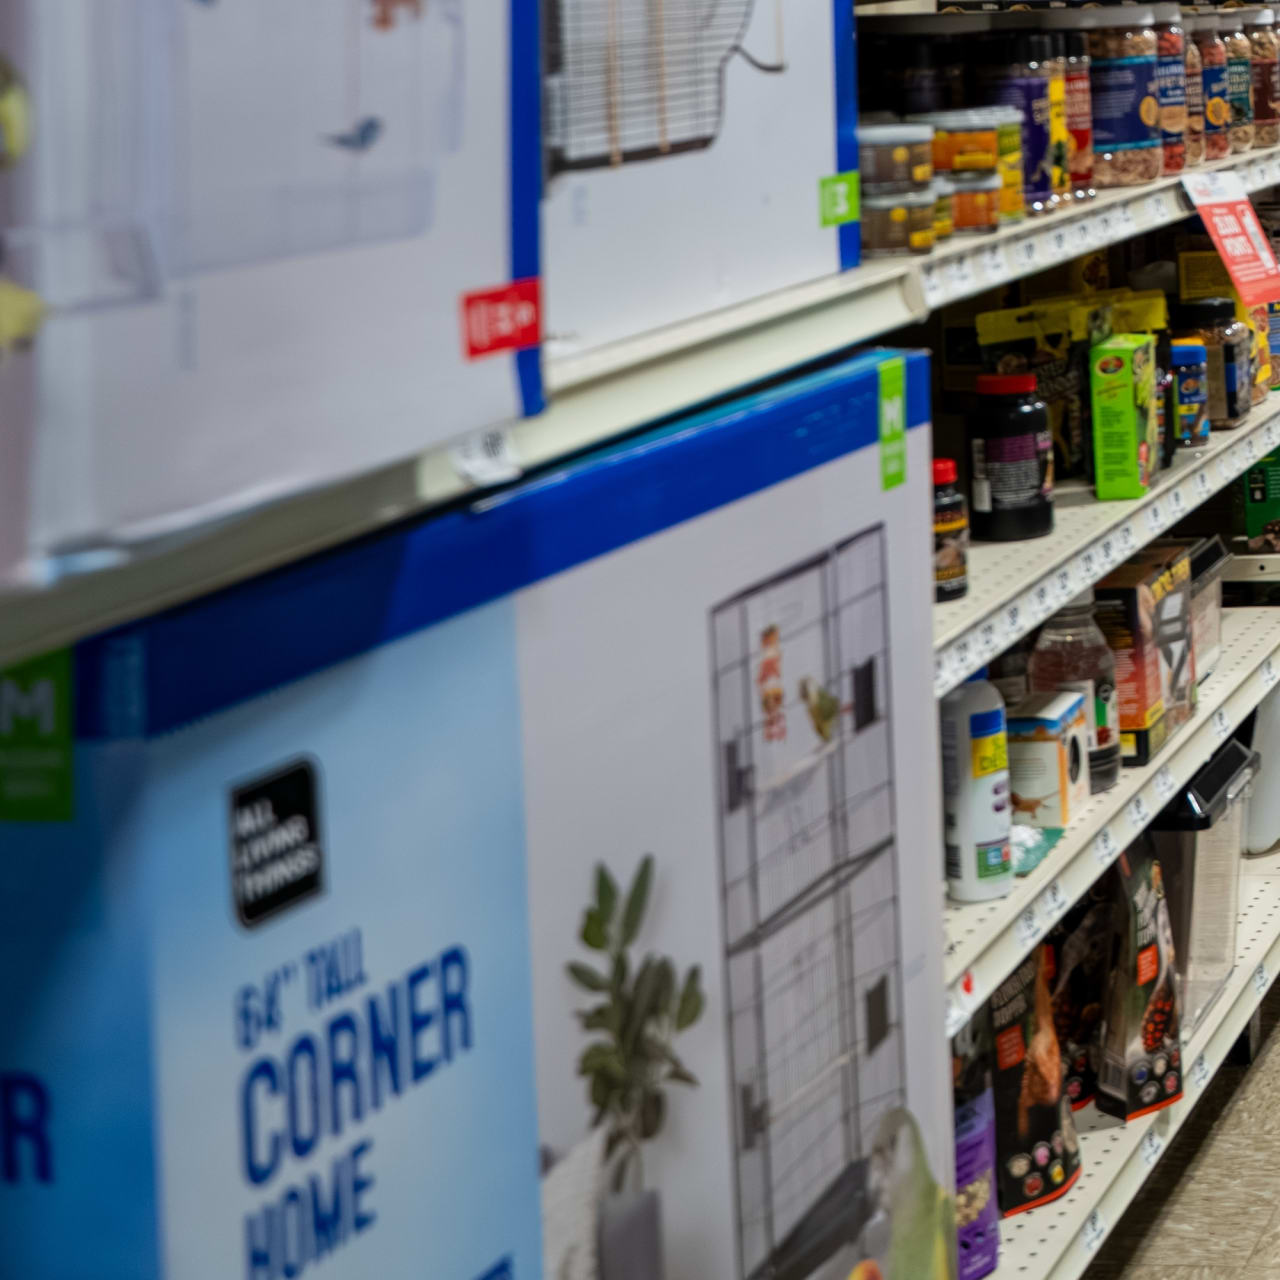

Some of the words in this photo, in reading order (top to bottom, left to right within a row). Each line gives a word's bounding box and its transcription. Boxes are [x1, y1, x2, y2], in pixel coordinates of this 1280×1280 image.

[304, 928, 368, 1013] TALL
[237, 944, 473, 1188] CORNER
[244, 1138, 377, 1280] HOME
